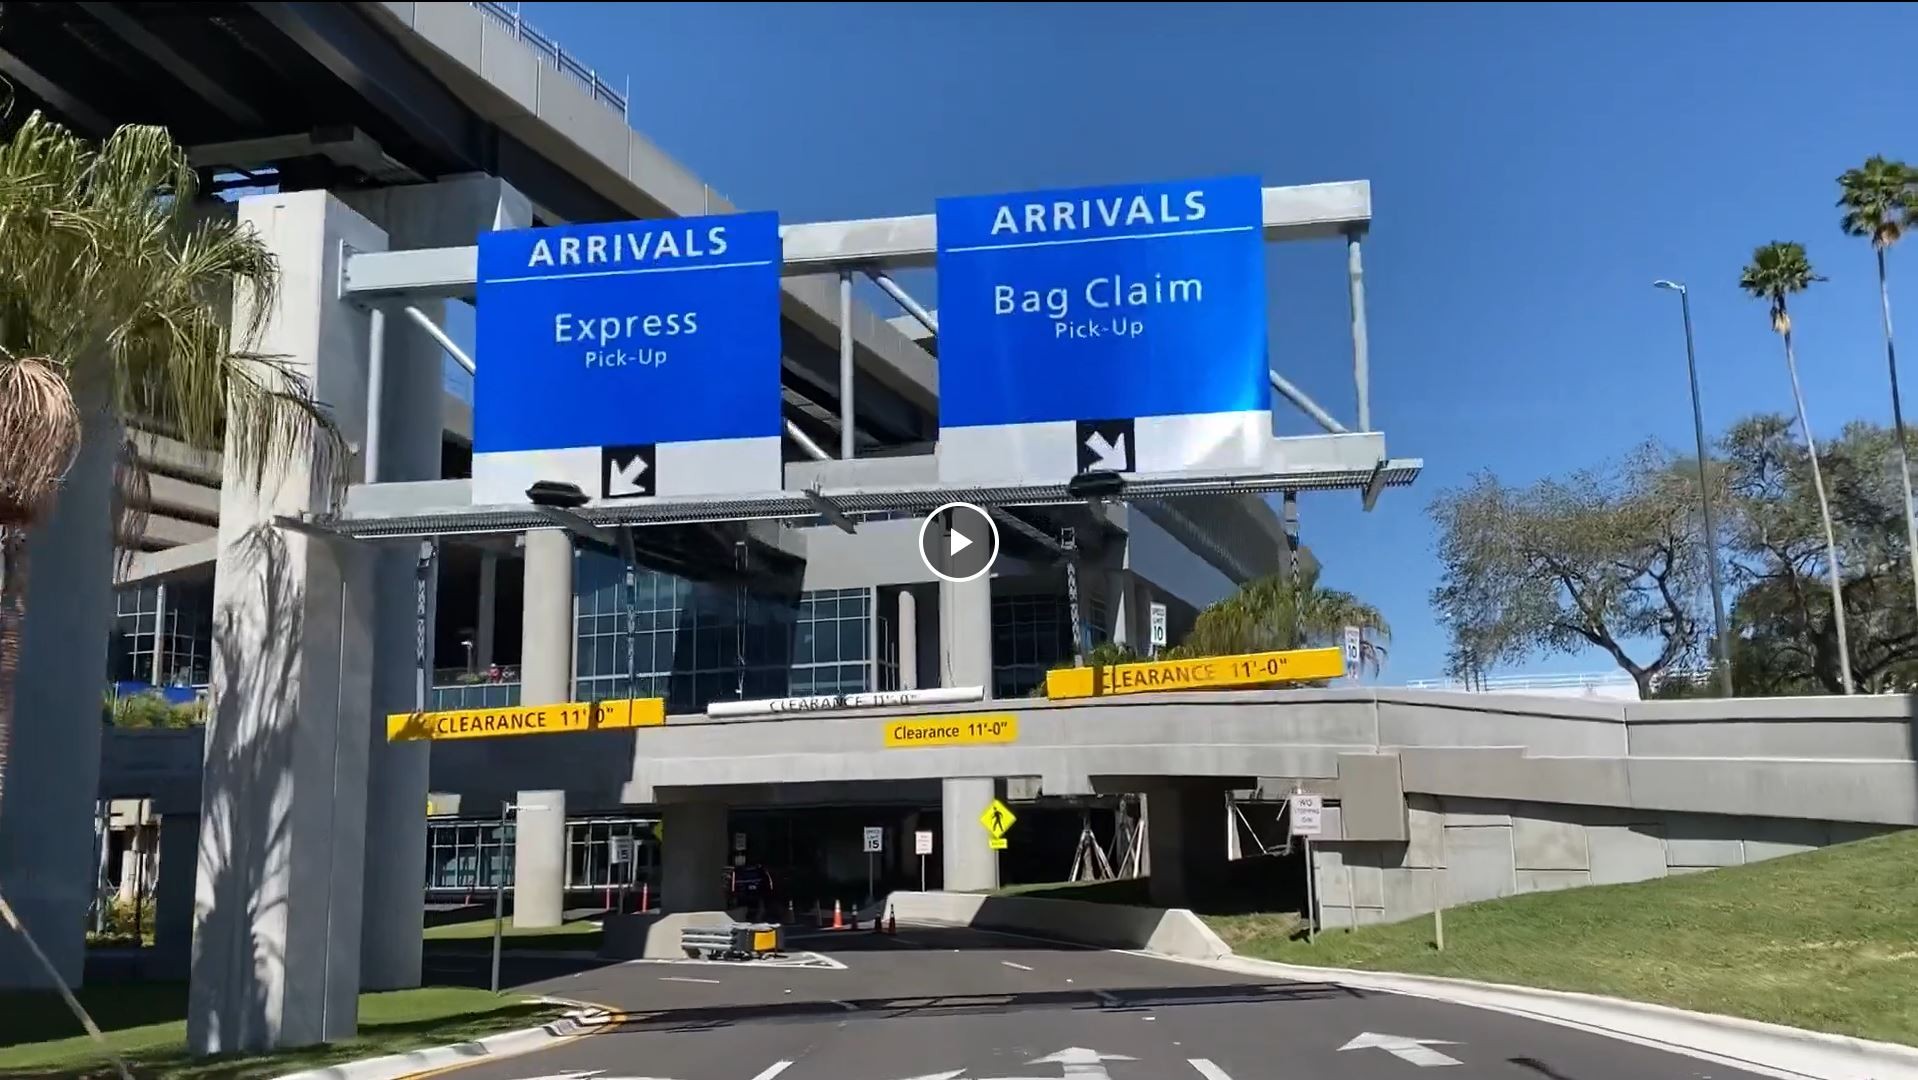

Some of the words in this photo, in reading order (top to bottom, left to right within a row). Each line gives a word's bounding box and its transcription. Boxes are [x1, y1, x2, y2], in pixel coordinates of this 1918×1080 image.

[991, 189, 1207, 235] ARRIVALS
[528, 226, 729, 268] ARRIVALS
[994, 284, 1067, 318] Bag
[1086, 274, 1205, 307] Claim
[555, 310, 699, 344] Express
[1054, 319, 1145, 339] Pick-Up
[585, 350, 668, 368] Pick-Up
[1153, 625, 1164, 641] 10
[437, 711, 547, 733] CLEARANCE
[560, 706, 614, 727] 11'0"
[894, 724, 960, 741] Clearance
[968, 721, 1008, 737] 11'-0"
[868, 840, 880, 849] 15
